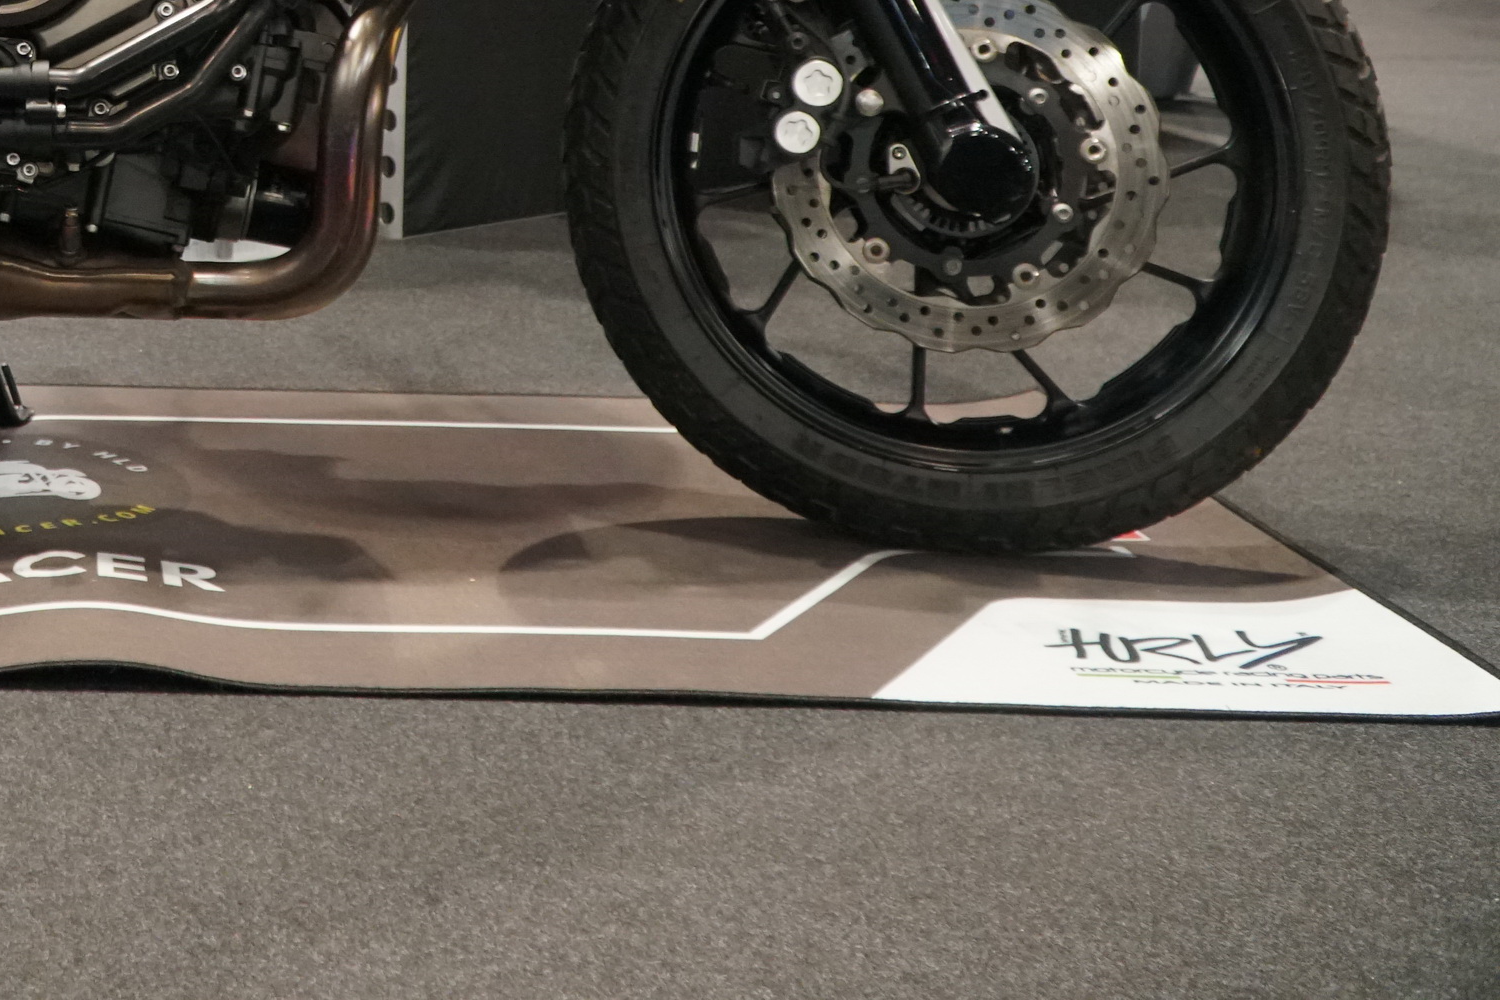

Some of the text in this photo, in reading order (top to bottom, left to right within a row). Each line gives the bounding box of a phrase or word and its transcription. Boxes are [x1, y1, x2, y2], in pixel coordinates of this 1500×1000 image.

[34, 438, 82, 450] BY
[1070, 666, 1217, 677] motorcycle
[1133, 679, 1223, 687] MADE
